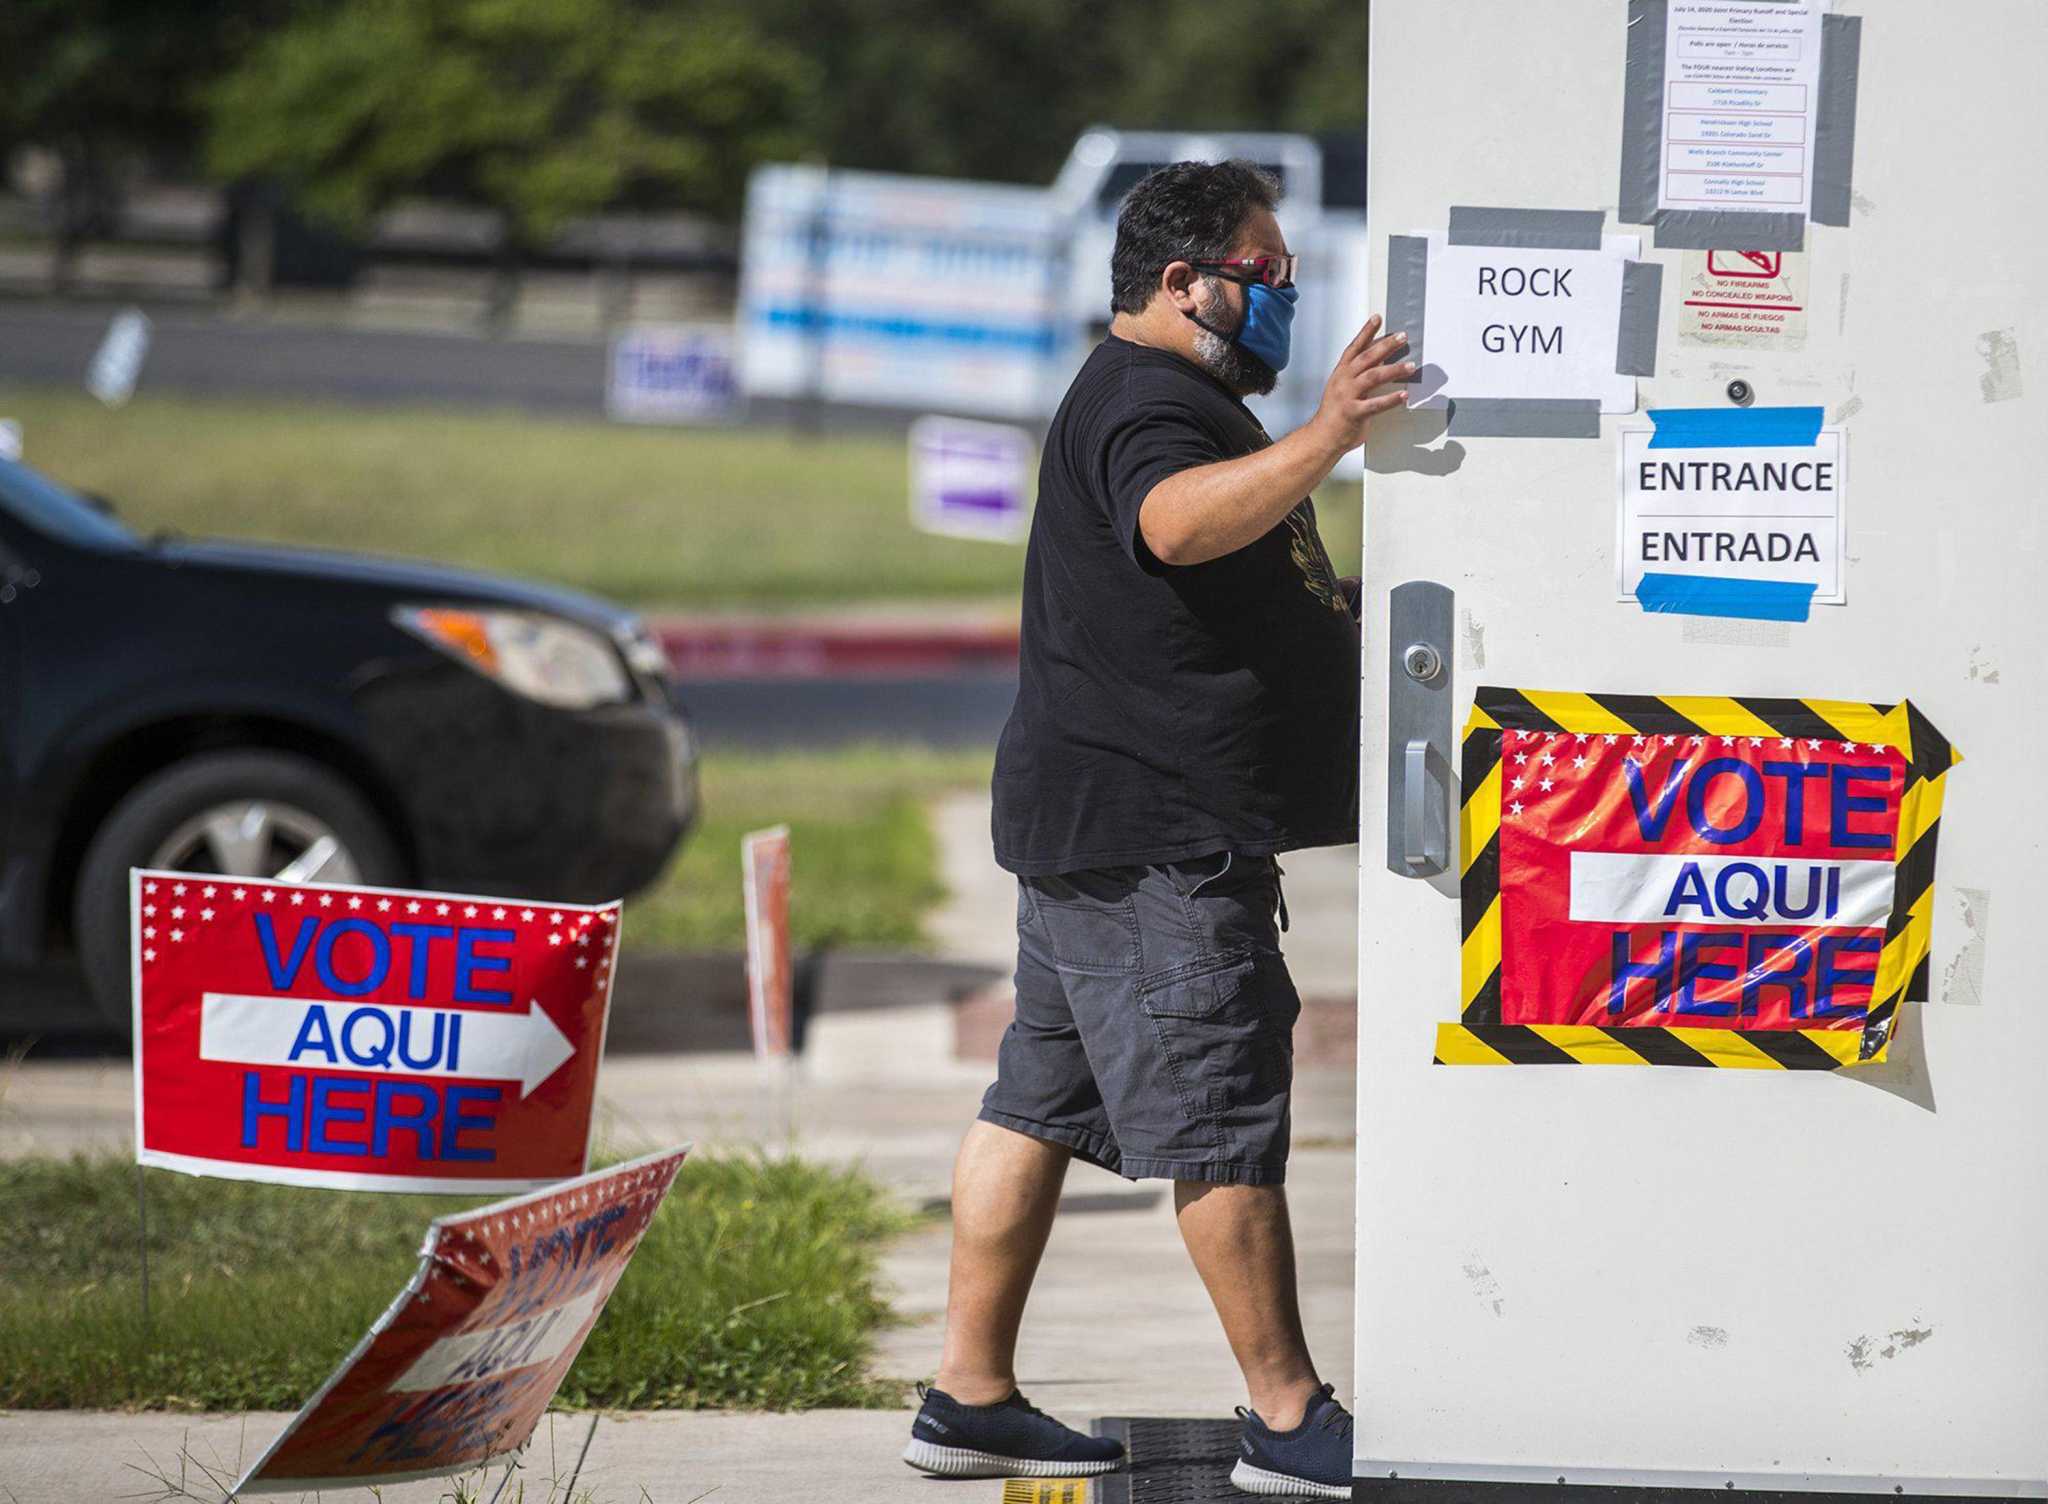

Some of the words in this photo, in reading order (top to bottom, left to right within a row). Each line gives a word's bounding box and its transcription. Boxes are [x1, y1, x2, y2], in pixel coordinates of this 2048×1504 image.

[1729, 8, 1752, 16] Primary
[1788, 9, 1808, 17] Special
[1736, 65, 1755, 73] Voting
[1734, 89, 1768, 97] Elementary
[1728, 150, 1762, 158] Community
[1479, 266, 1573, 298] ROCK
[1706, 290, 1753, 300] CONCEALED
[1755, 293, 1793, 302] WEAPONS
[1730, 281, 1770, 289] FIREARMS
[1711, 311, 1739, 319] ARMAS
[1753, 313, 1785, 321] FUEGOS
[1715, 323, 1742, 331] ARMAS
[1744, 325, 1780, 334] OCULTAS
[1481, 324, 1564, 355] GYM
[1639, 461, 1834, 492] ENTRANCE
[1641, 531, 1821, 563] ENTRADA
[1622, 756, 1893, 849] VOTE
[1663, 861, 1841, 922] AQUI
[254, 912, 516, 1006] VOTE
[1606, 930, 1883, 1019] HERE
[288, 1004, 462, 1072] AQUI
[241, 1071, 504, 1163] HERE
